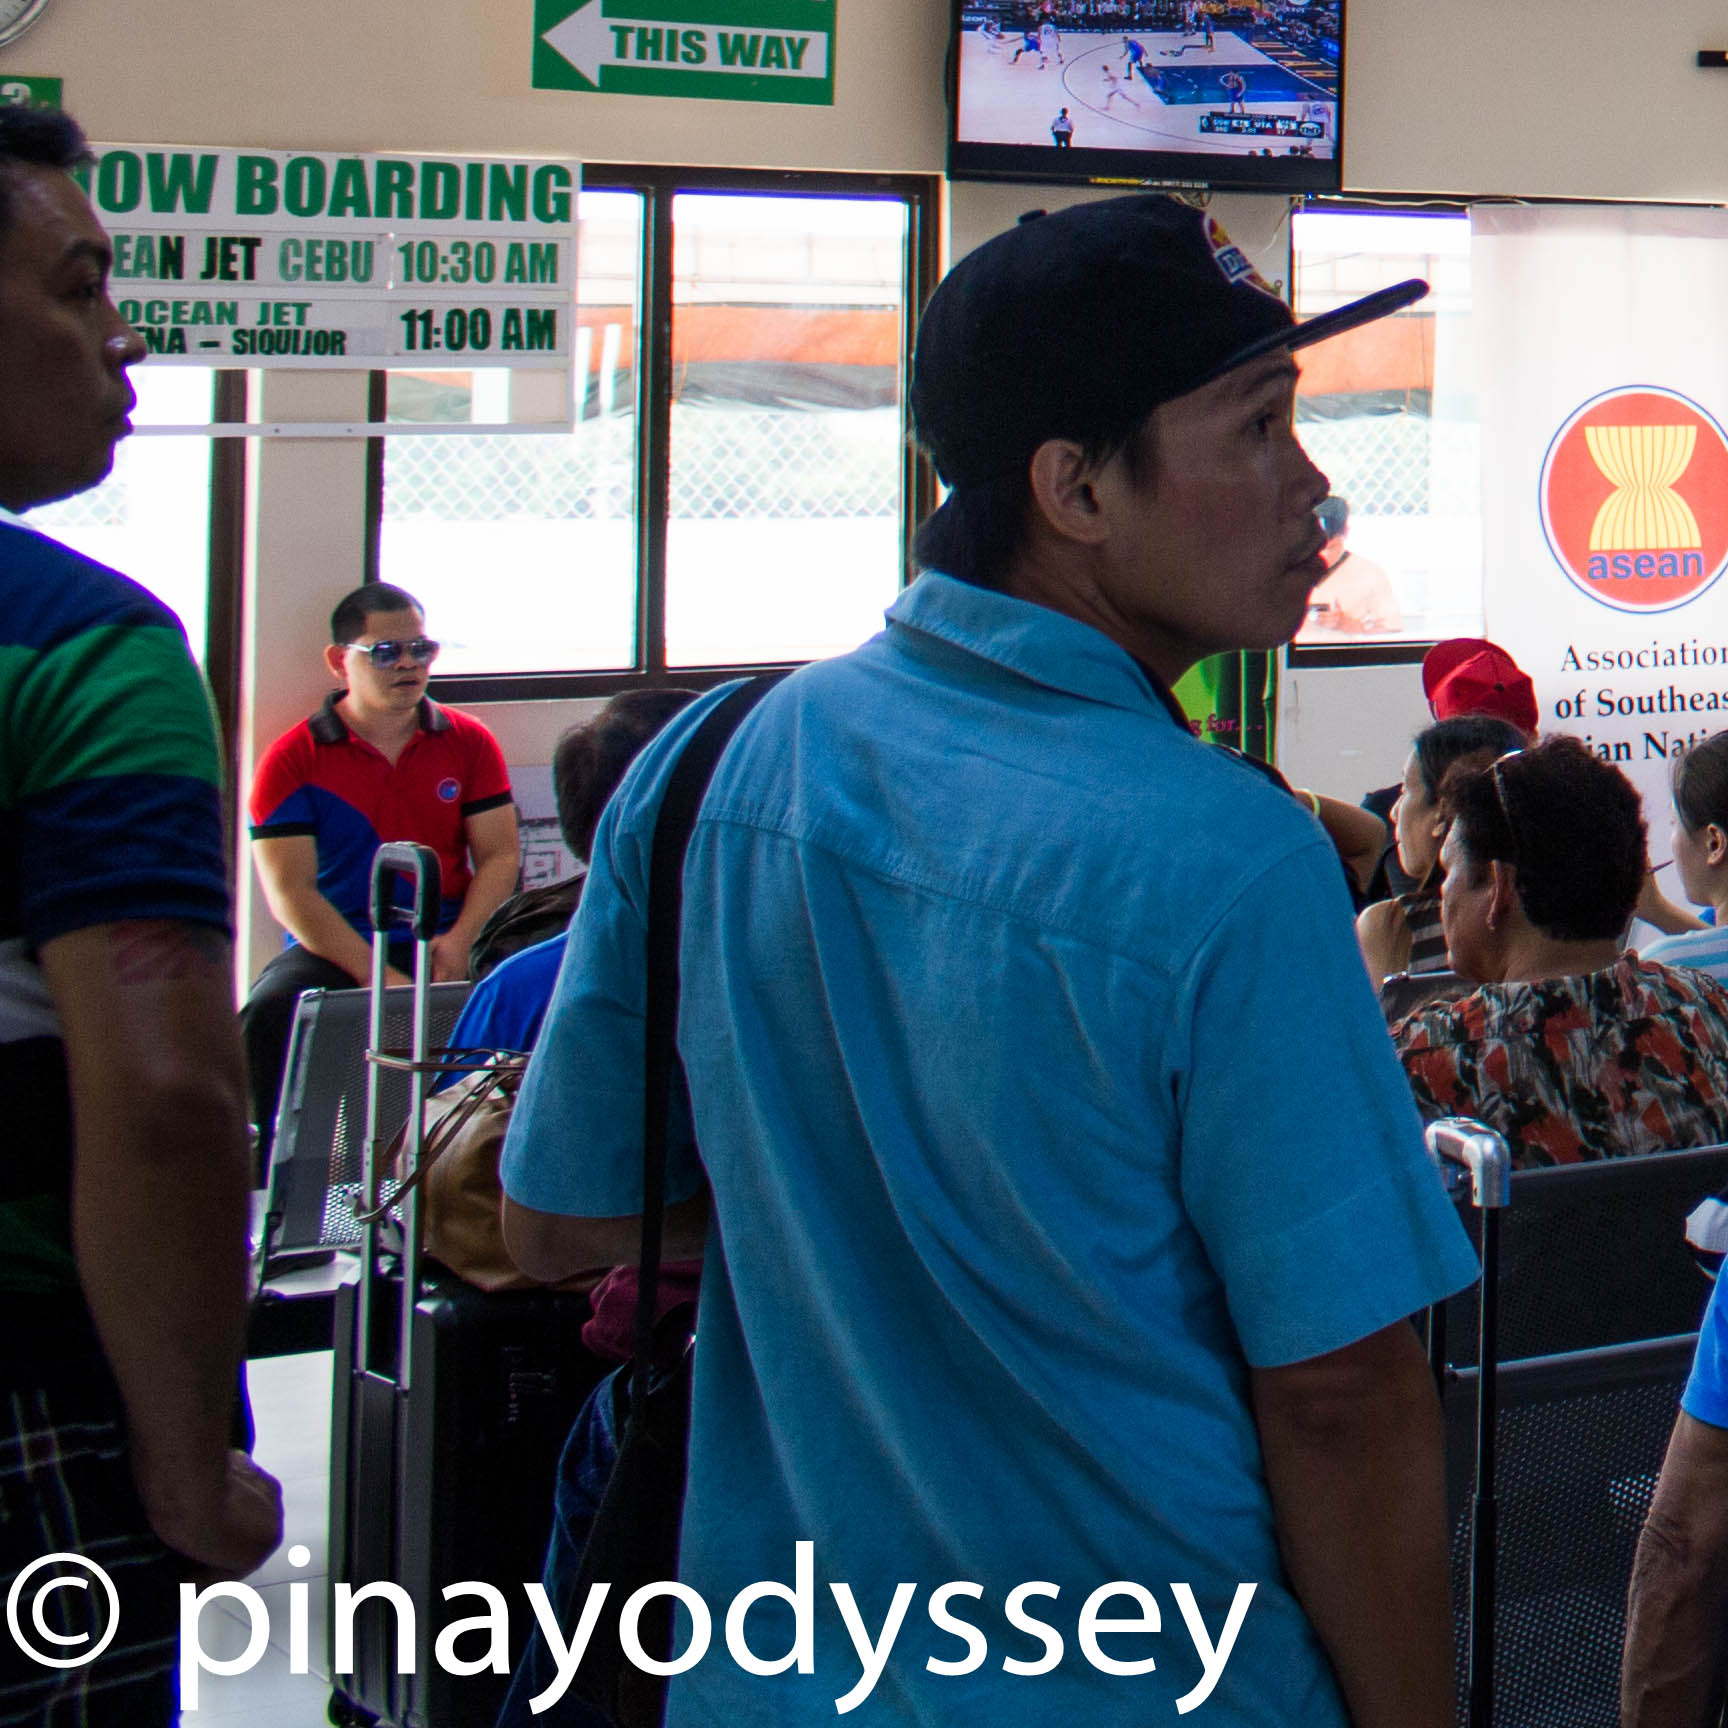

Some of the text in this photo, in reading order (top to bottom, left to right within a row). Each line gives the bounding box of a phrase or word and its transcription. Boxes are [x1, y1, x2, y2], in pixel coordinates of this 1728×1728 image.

[608, 24, 811, 71] THIS WAY
[235, 154, 573, 224] BOARDING
[112, 233, 375, 282] EAN JET CEBU
[397, 239, 559, 284] 10:30 AM
[118, 299, 313, 327] OCEAN JET
[400, 306, 558, 352] 11:00 AM
[231, 327, 347, 357] SIQUIJOR
[1587, 550, 1704, 581] asean
[1555, 688, 1587, 720] of
